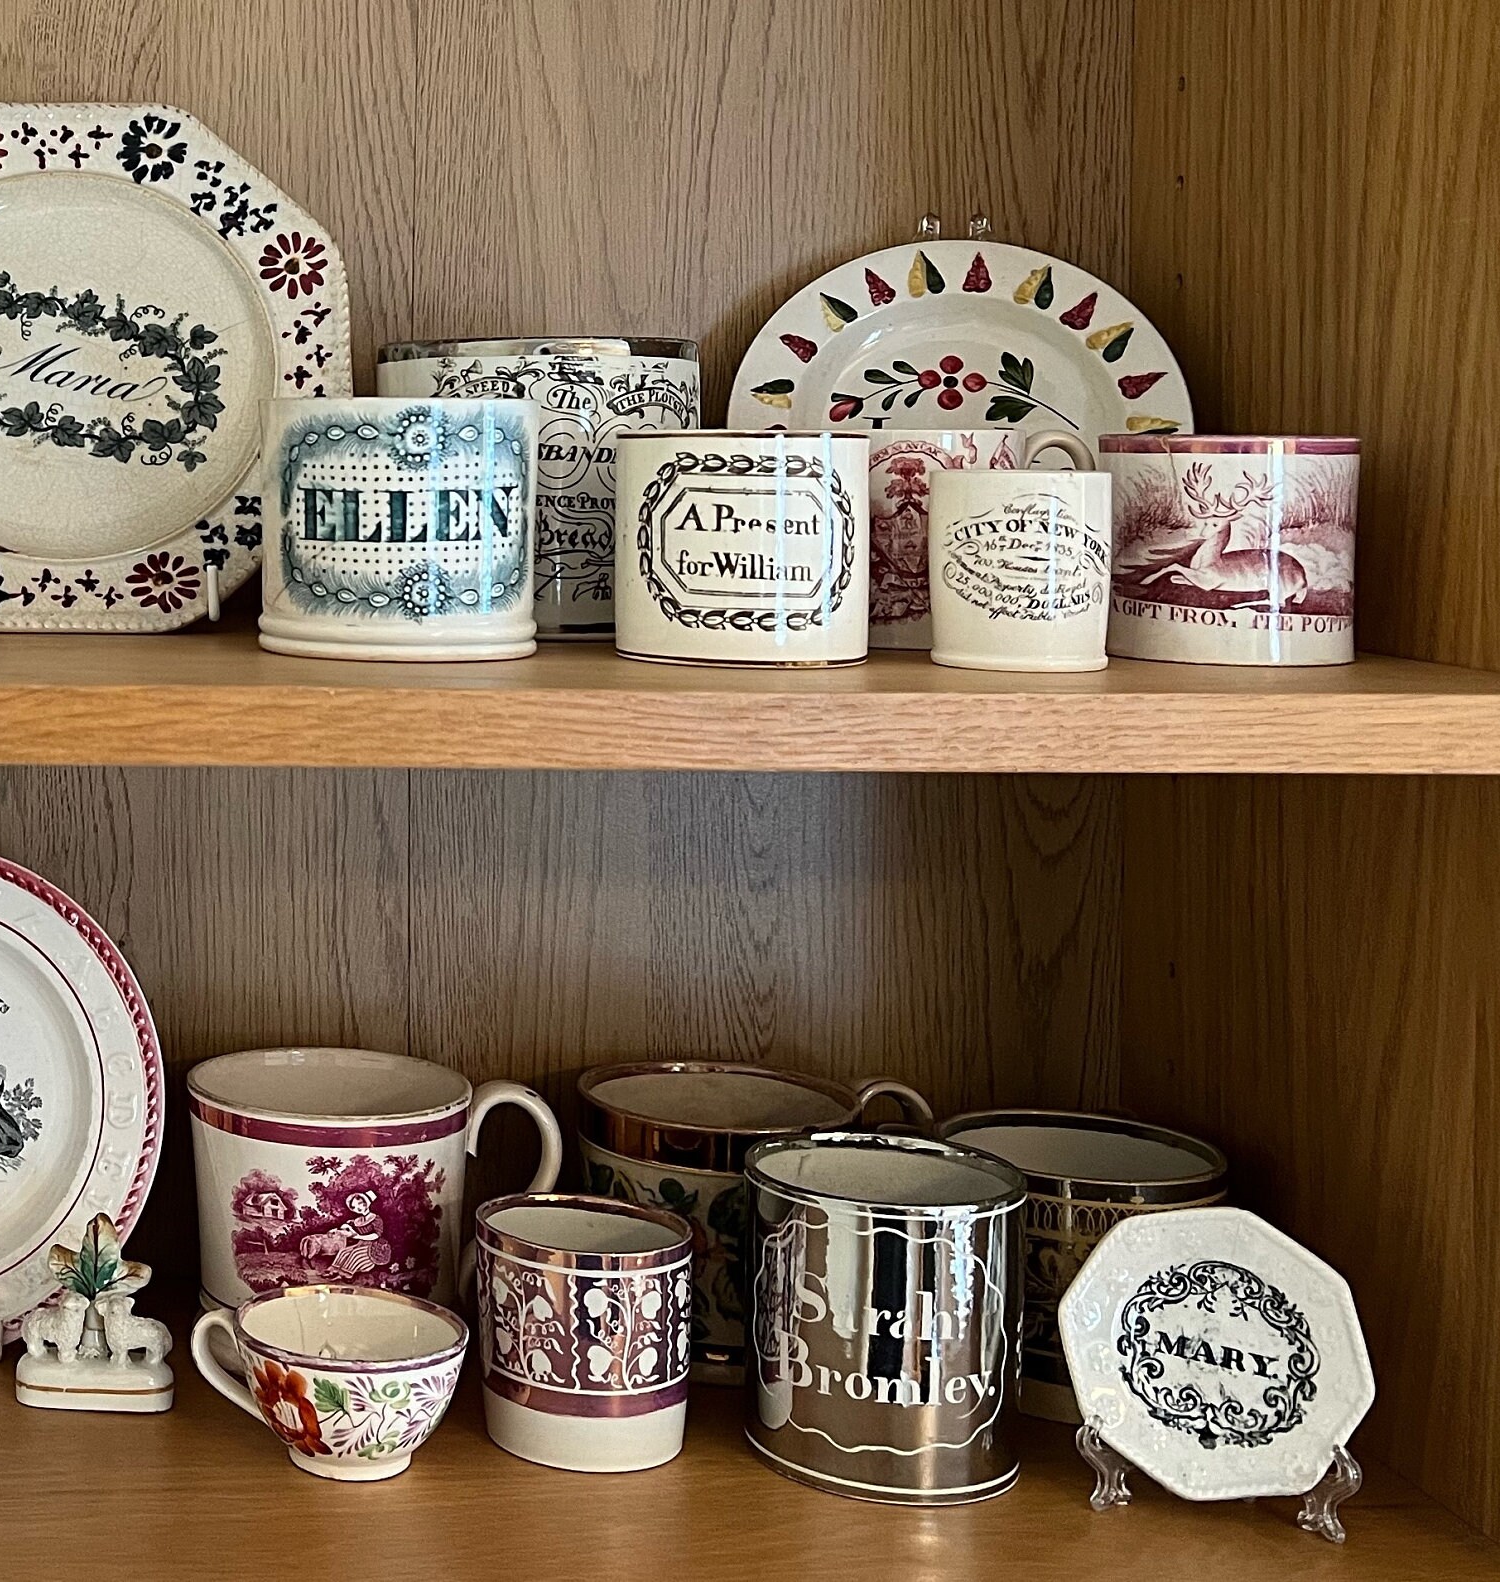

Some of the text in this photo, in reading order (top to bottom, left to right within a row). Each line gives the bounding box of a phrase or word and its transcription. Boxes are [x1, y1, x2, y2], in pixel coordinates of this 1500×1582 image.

[465, 381, 511, 397] SPEED
[552, 386, 592, 410] The
[615, 392, 645, 412] THE
[297, 484, 519, 542] ELLEN
[675, 503, 820, 535] A Present
[954, 519, 1108, 562] CITY OF NEW YORK
[676, 550, 813, 581] for William
[1122, 600, 1162, 620] GIFT
[791, 1272, 954, 1341] Srah
[1153, 1330, 1280, 1380] MARY.
[762, 1329, 996, 1419] Bromley.
